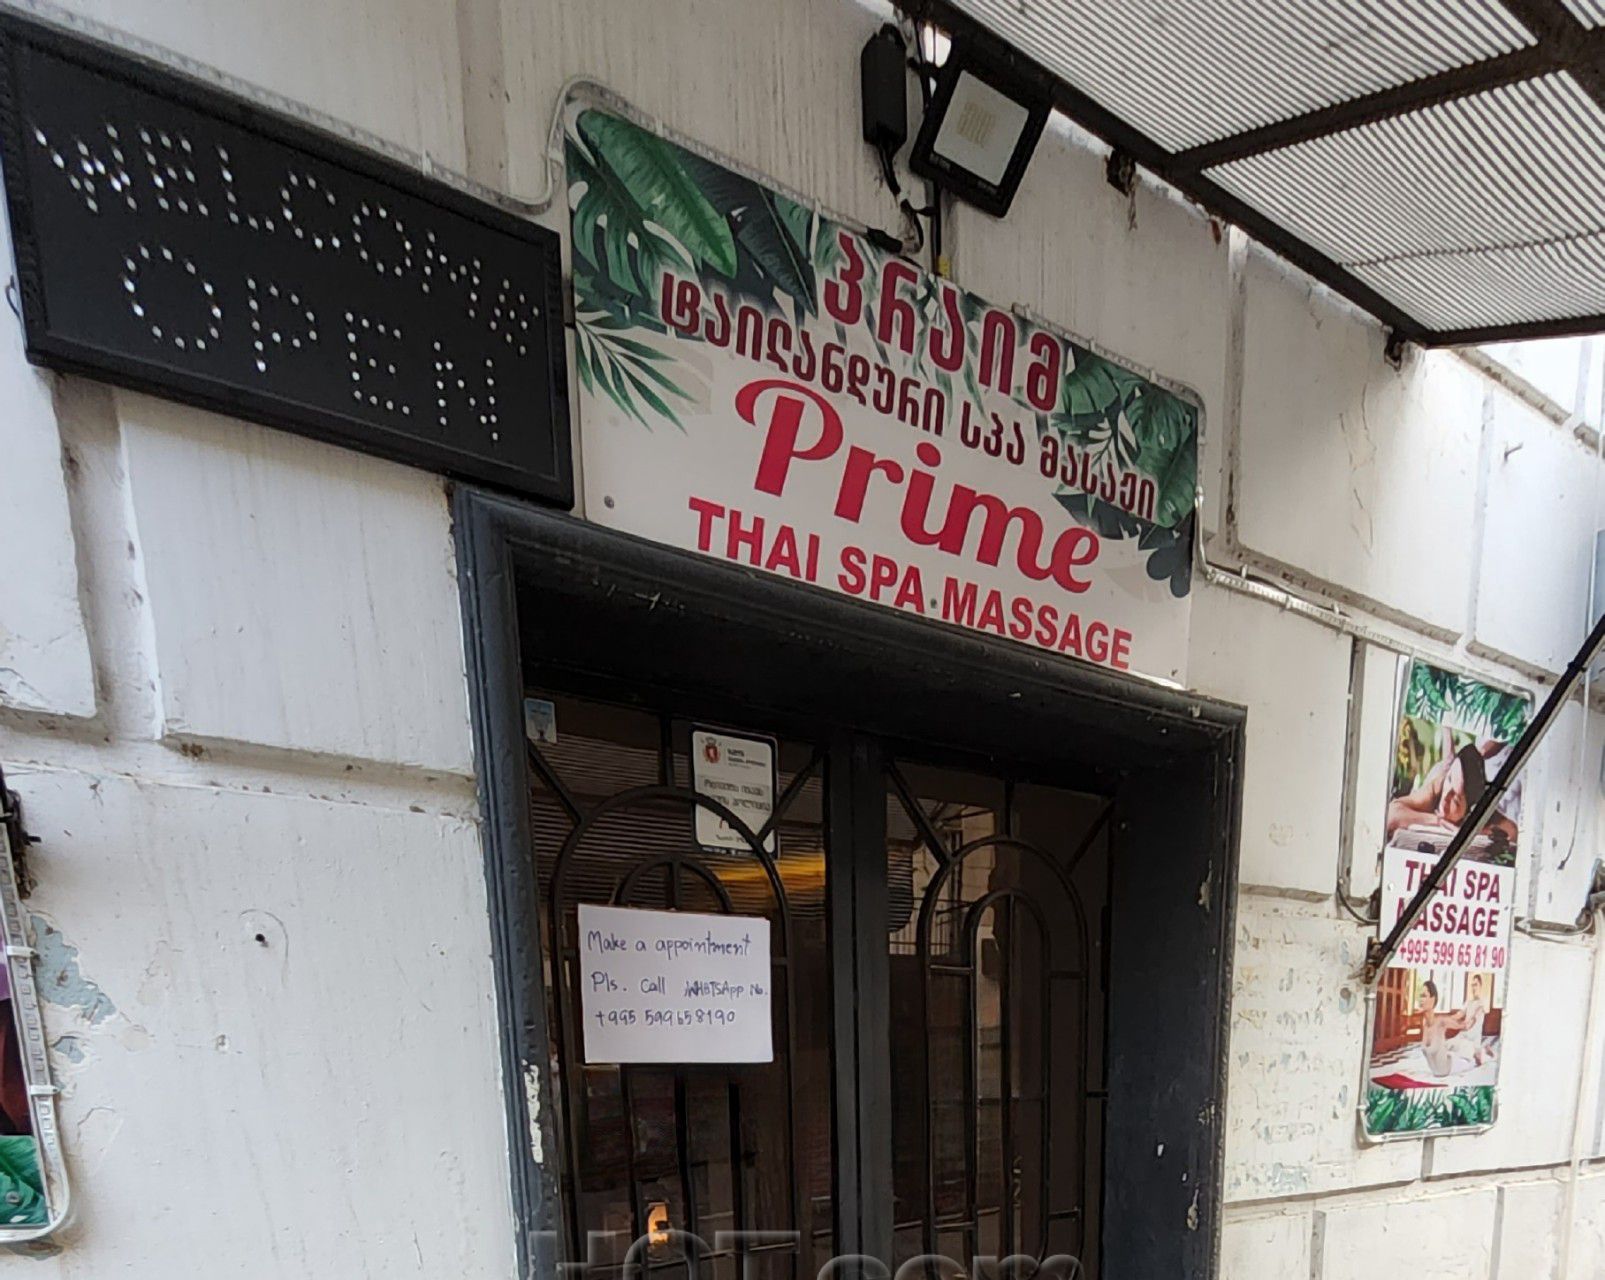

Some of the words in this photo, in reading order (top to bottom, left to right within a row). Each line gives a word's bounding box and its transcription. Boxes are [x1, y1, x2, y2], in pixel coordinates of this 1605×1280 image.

[35, 123, 541, 356] WELCOME
[823, 230, 1061, 412] პრაიმ
[121, 245, 500, 441] OPEN
[660, 271, 946, 437] ტაილანდური
[959, 400, 1026, 466] სპა
[1039, 434, 1157, 520] მასაჟი
[734, 378, 1101, 594] Prime
[688, 496, 821, 583] THAI
[837, 545, 925, 614] SPA
[941, 576, 1133, 669] MASSAGE
[587, 930, 627, 953] Make
[635, 940, 647, 951] a
[655, 930, 751, 960] appointment
[1400, 938, 1430, 964] +995
[1432, 940, 1455, 966] 599
[1457, 942, 1472, 967] 65
[1474, 943, 1488, 968] 81
[1491, 945, 1505, 969] 90
[1463, 868, 1500, 903] SPA
[591, 971, 627, 992] Pls.
[595, 1009, 636, 1027] +995
